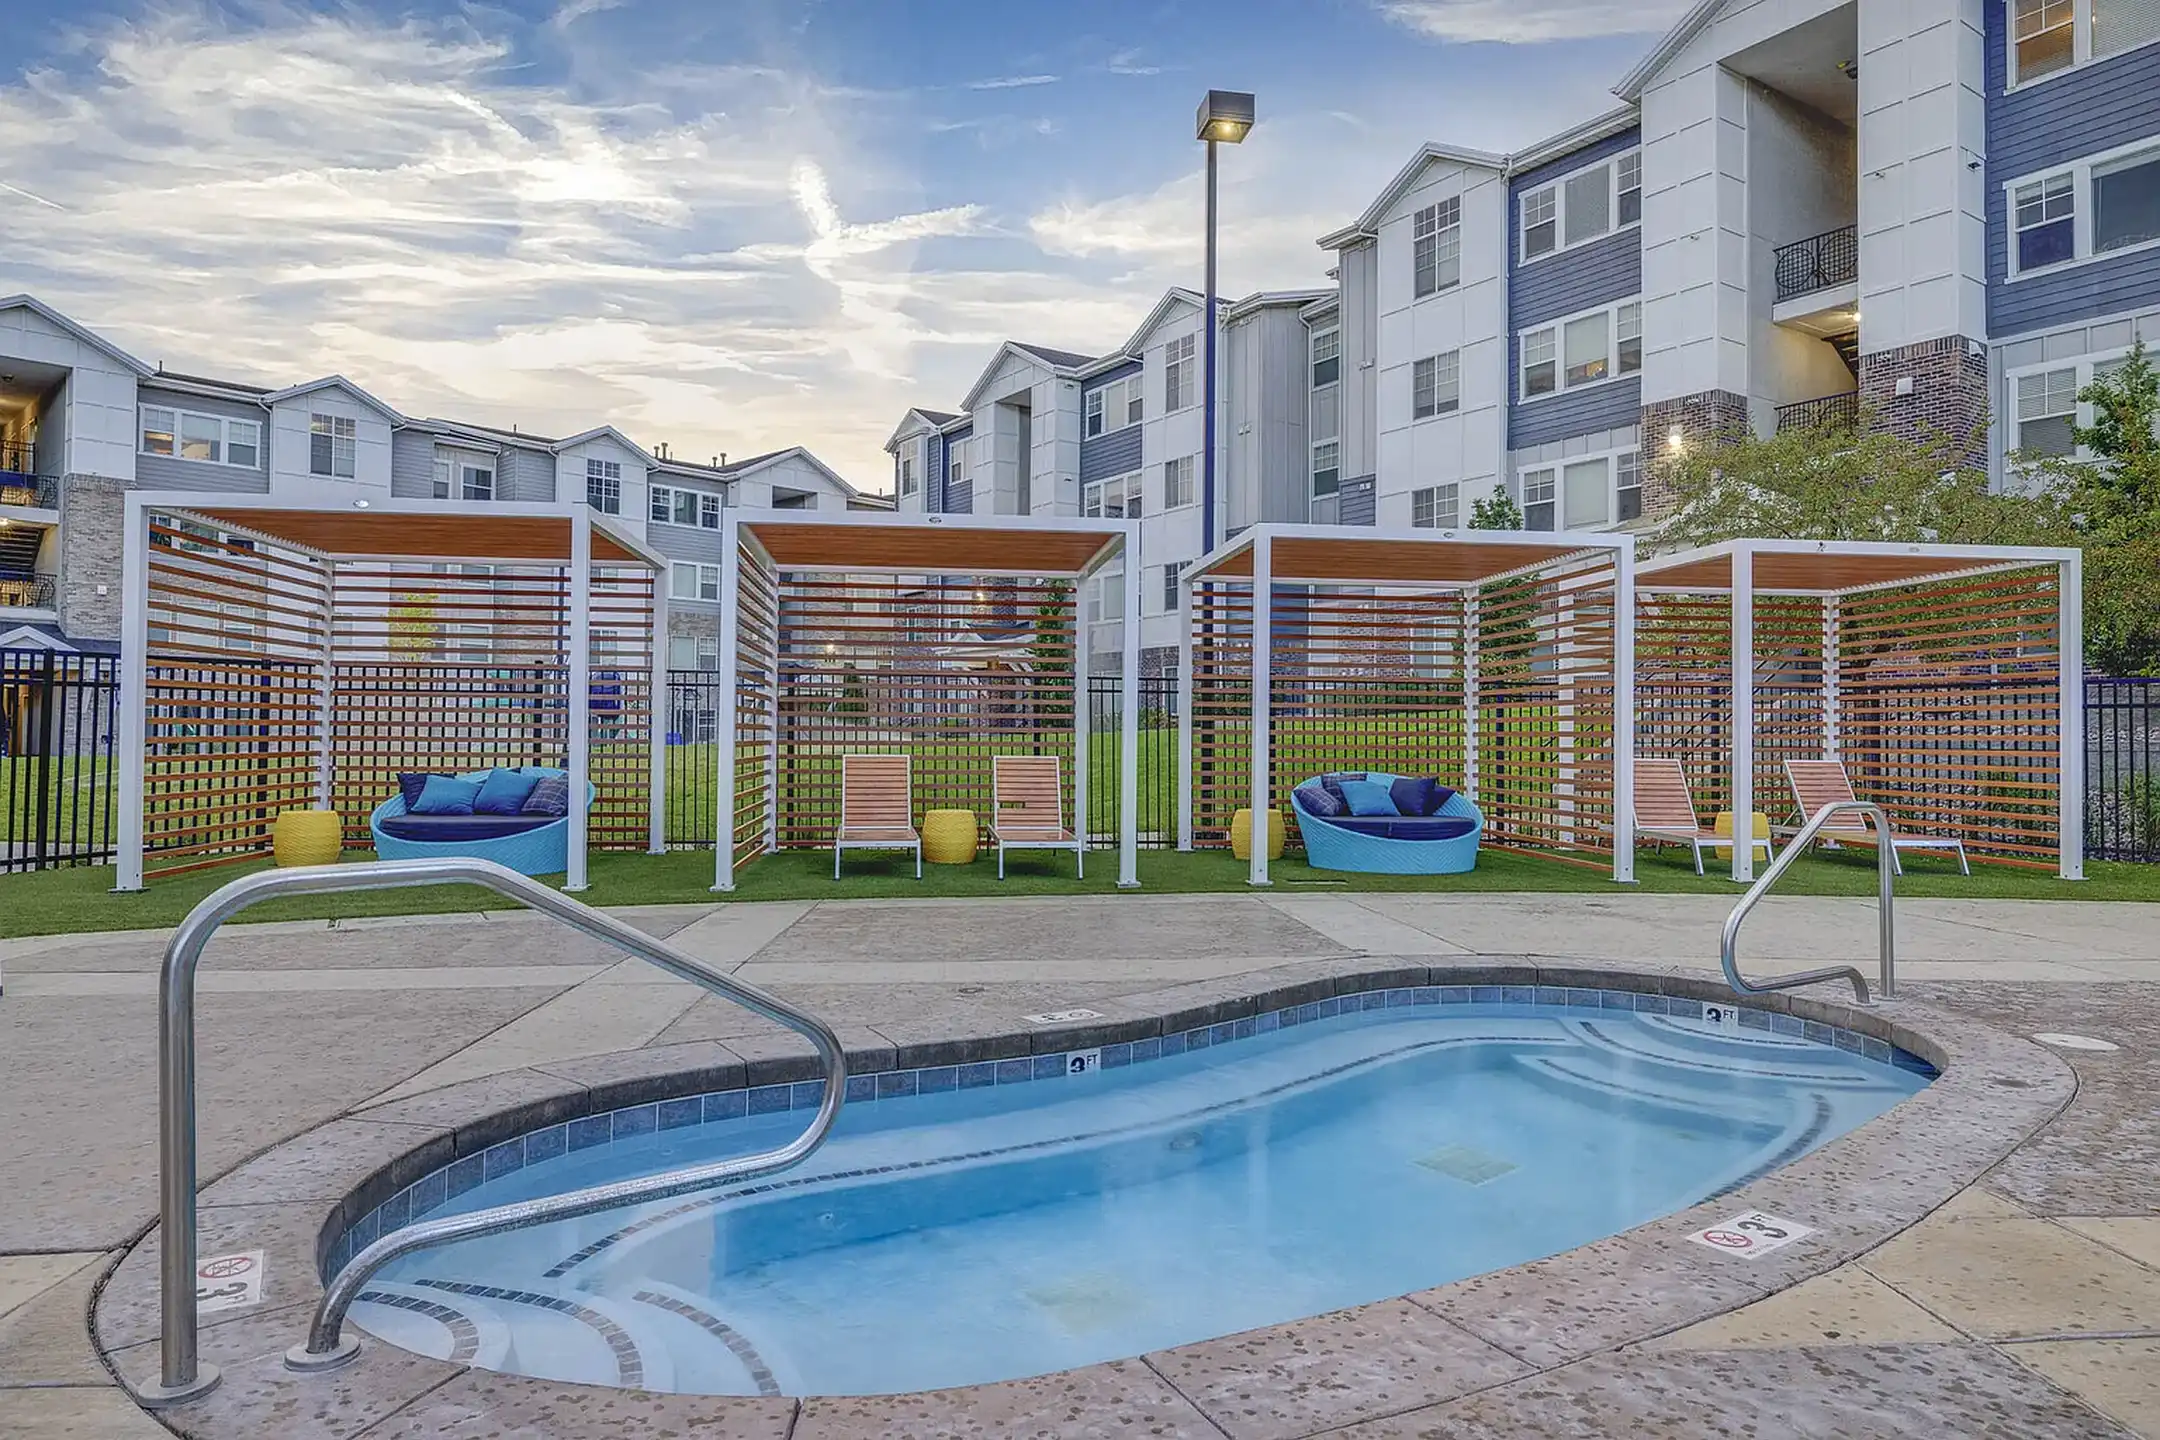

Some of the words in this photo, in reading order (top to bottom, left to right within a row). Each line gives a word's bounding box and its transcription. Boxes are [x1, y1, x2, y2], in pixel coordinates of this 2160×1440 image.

[1723, 1010, 1735, 1019] FT
[1070, 1057, 1085, 1073] 3
[1086, 1054, 1098, 1065] FT
[1737, 1221, 1788, 1239] 3
[196, 1282, 248, 1301] 3
